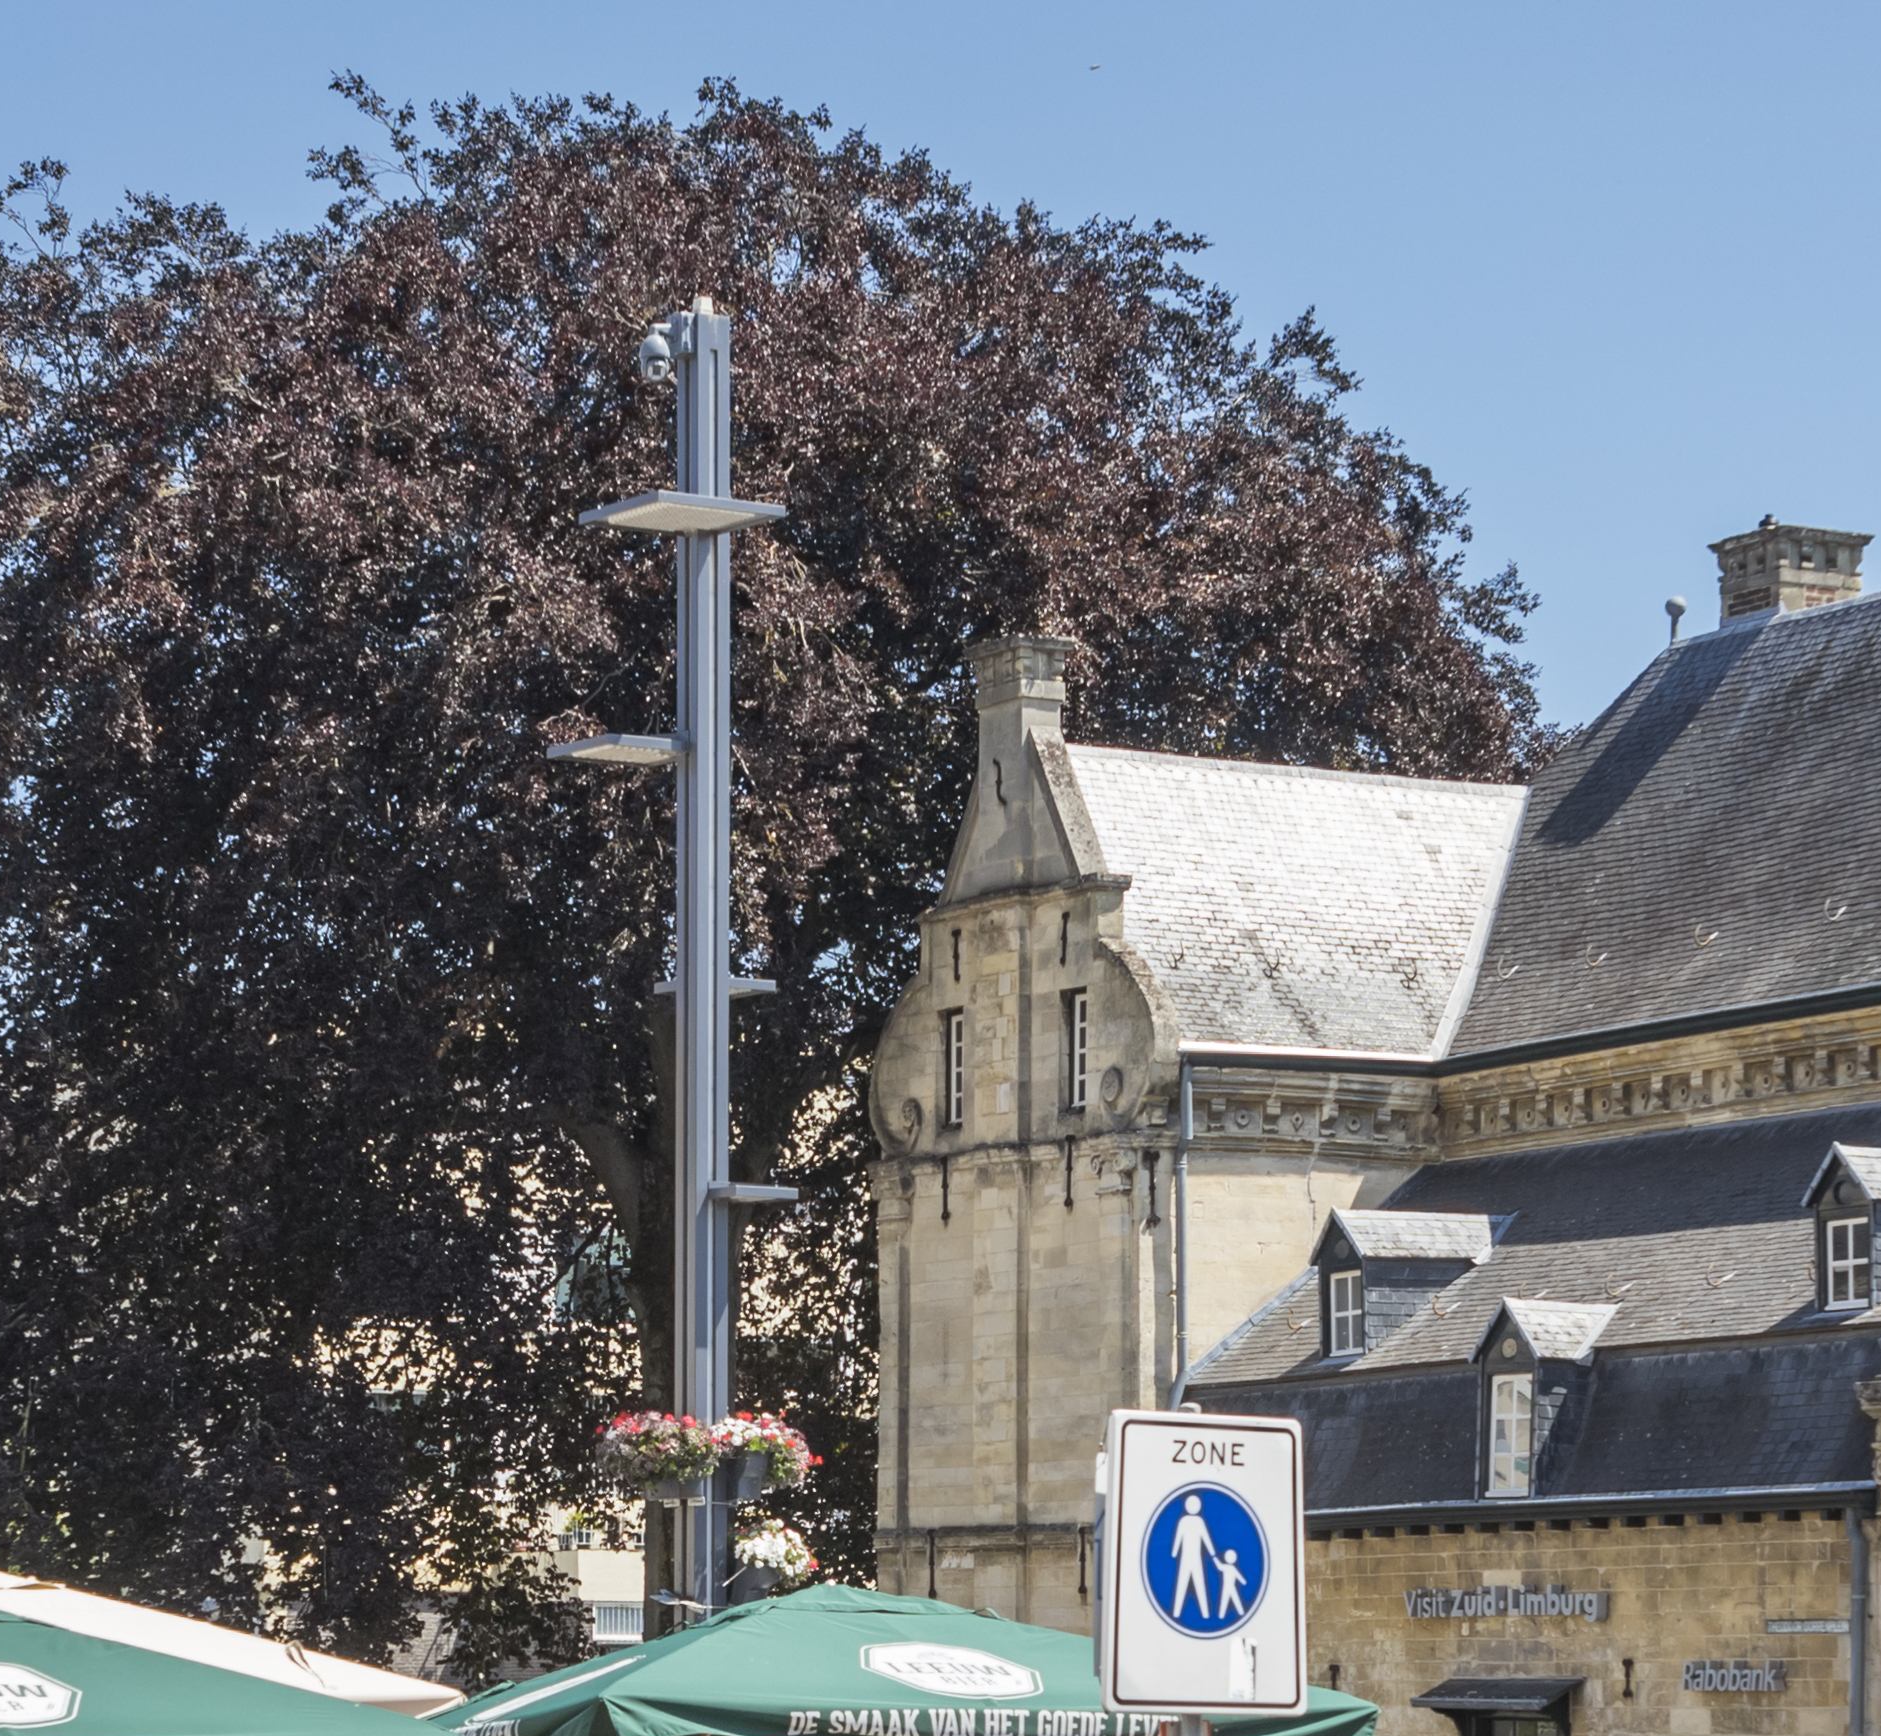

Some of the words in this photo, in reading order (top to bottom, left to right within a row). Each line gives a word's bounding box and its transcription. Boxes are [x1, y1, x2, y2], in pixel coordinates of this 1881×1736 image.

[1171, 1439, 1246, 1467] ZONE
[1403, 1588, 1446, 1618] Visit
[883, 1661, 1013, 1676] LEEUW
[1681, 1659, 1777, 1692] Rabobank
[787, 1710, 821, 1736] DE
